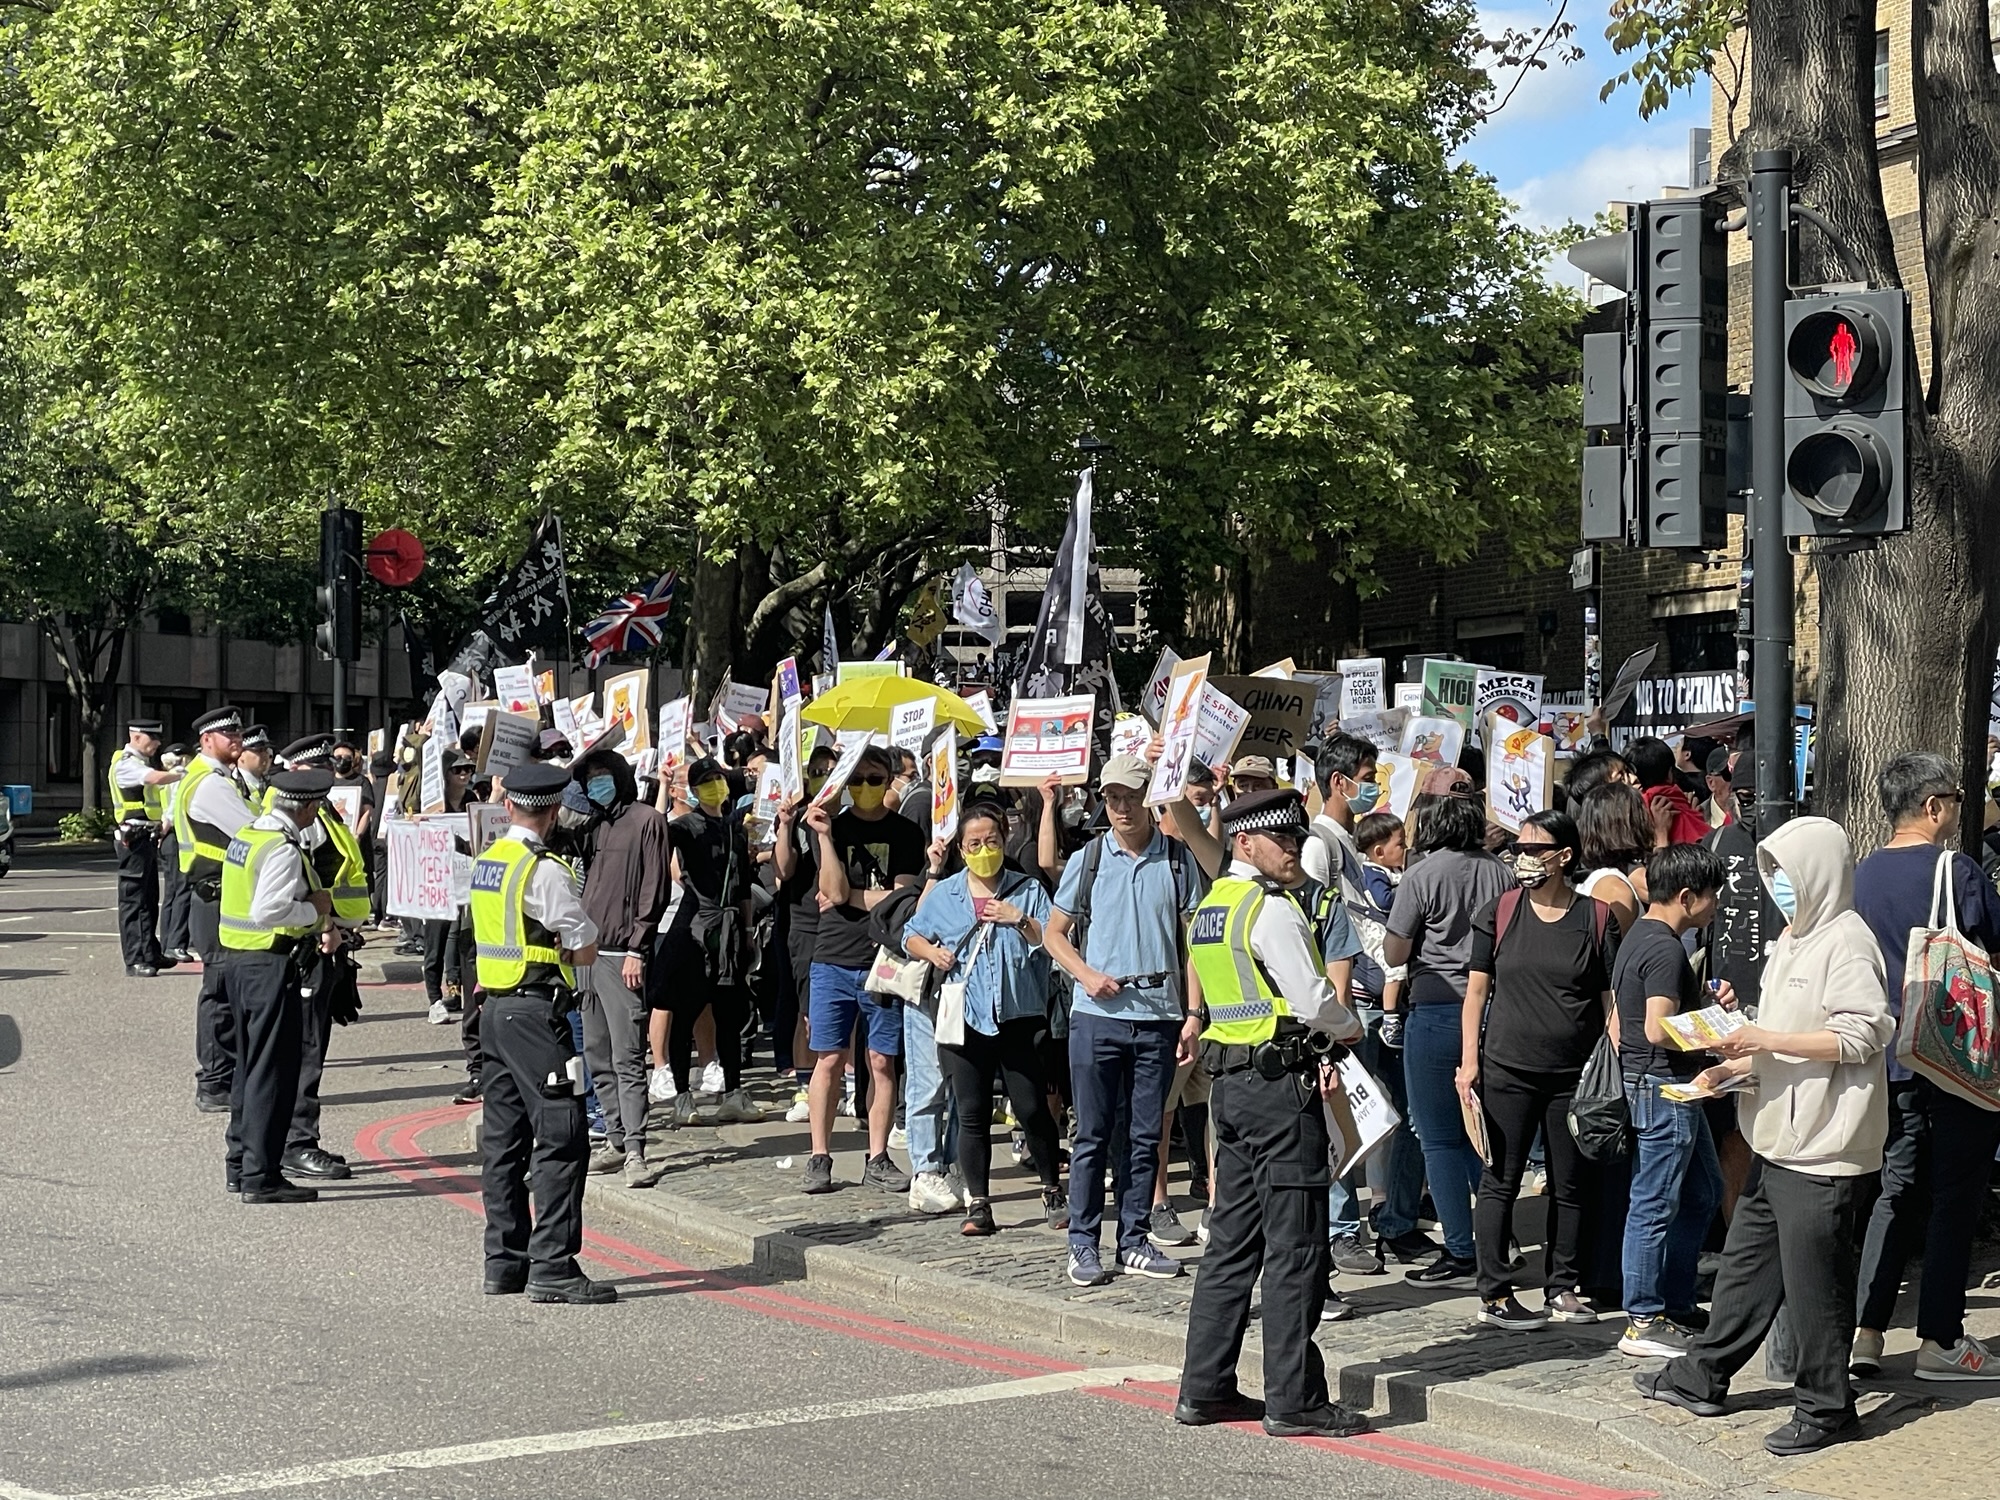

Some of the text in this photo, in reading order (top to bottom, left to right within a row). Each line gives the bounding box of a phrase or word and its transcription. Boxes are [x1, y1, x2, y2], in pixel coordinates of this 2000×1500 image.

[1352, 680, 1373, 688] CCP'S
[1479, 677, 1536, 694] MEGA
[1350, 688, 1377, 697] TROJAN
[1352, 696, 1376, 704] HORSE
[1404, 694, 1421, 702] CHIN
[1478, 689, 1537, 705] EMBASSY
[1636, 672, 1735, 715] NO TO CHINA'S
[1211, 699, 1240, 723] SPIES
[1243, 689, 1304, 717] CHINA
[902, 708, 924, 724] STOP
